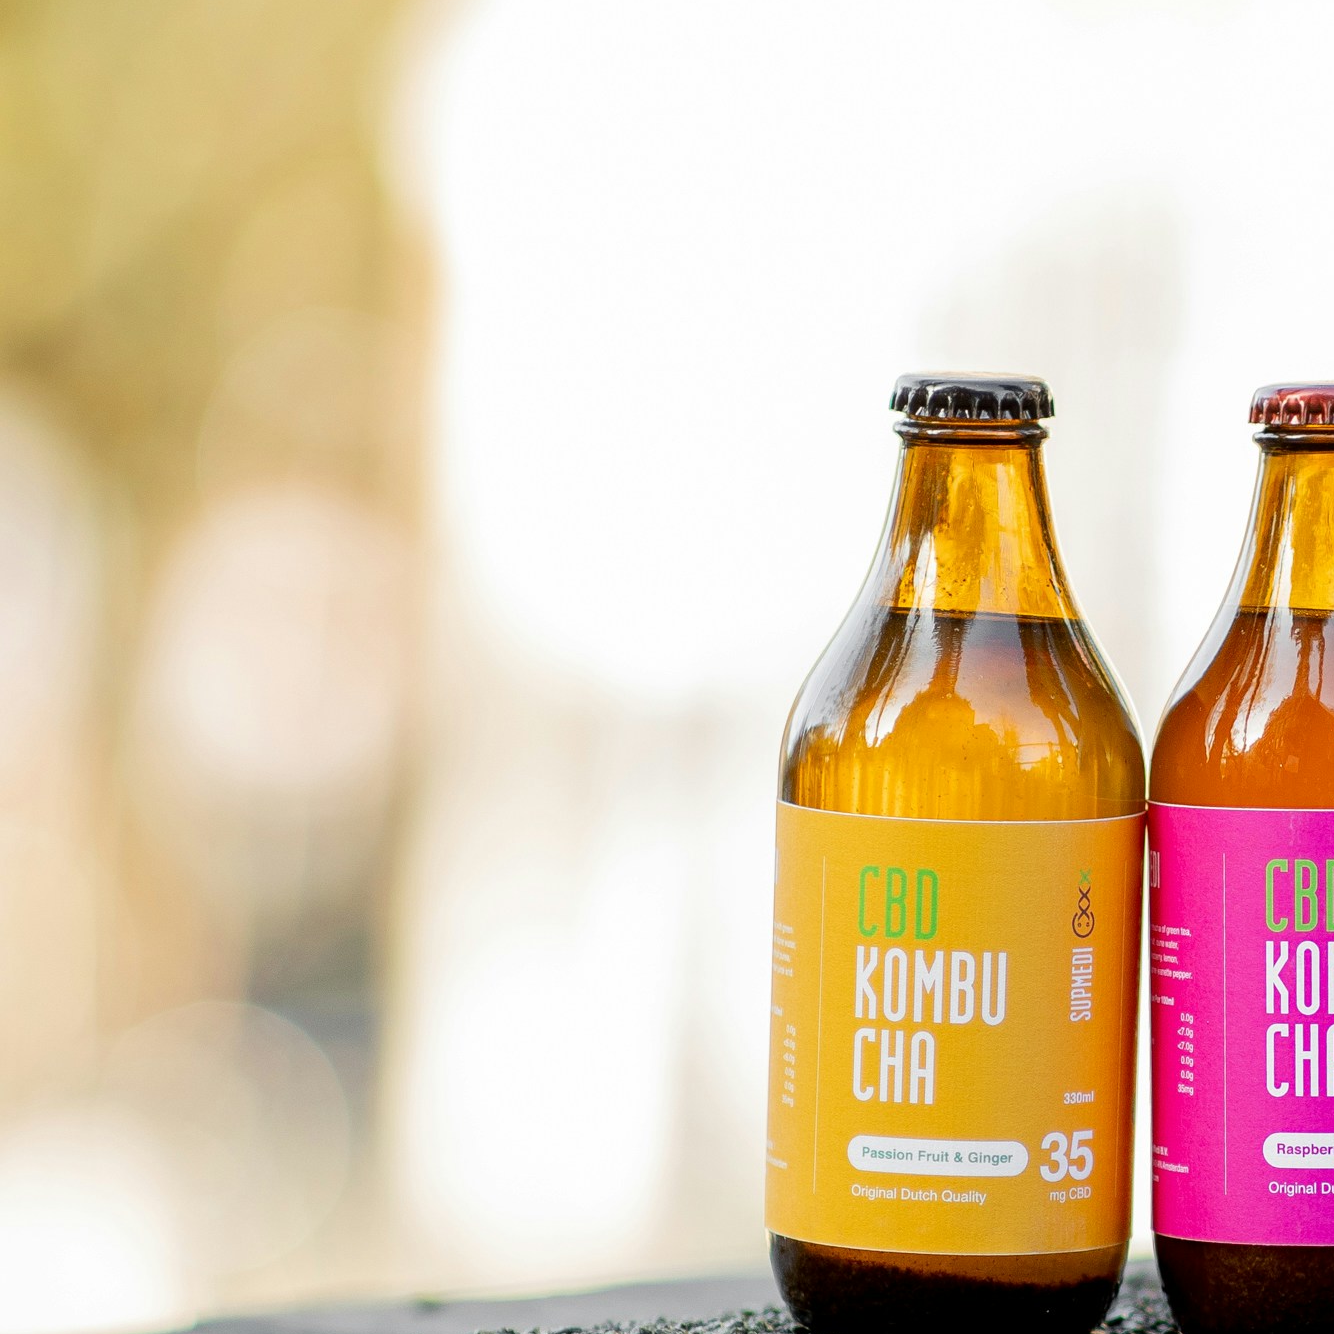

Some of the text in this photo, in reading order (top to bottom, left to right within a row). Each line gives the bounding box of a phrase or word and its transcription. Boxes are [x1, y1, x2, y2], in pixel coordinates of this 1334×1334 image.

[858, 865, 939, 941] CBD
[854, 945, 1008, 1026] KOMBU
[1068, 947, 1094, 1022] SUPMEDI
[1180, 1012, 1194, 1024] 0.0g
[852, 1028, 935, 1105] CHA
[1064, 1090, 1095, 1105] 330ml
[862, 1146, 1013, 1166] Passion Fruit & Ginger
[1040, 1129, 1095, 1183] 35
[851, 1184, 987, 1206] Original Dutch Quality
[1050, 1186, 1092, 1203] mg CBD
[1268, 1181, 1317, 1197] Original
